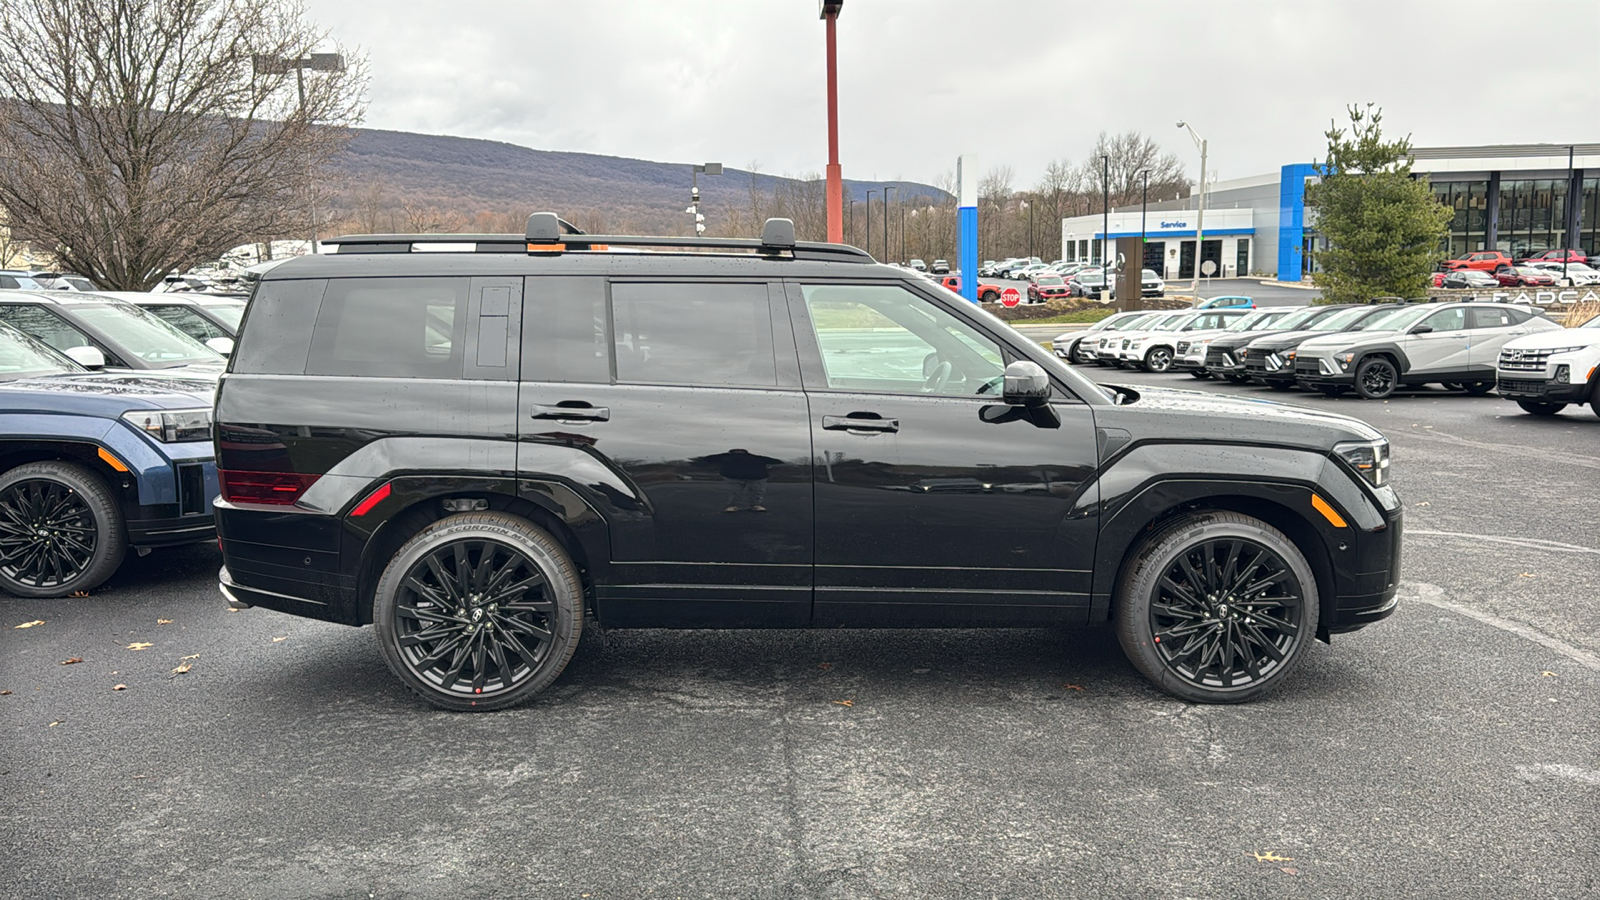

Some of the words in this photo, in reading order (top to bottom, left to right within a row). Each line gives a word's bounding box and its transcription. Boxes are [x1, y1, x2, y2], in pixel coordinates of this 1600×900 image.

[1160, 220, 1187, 229] Service
[1002, 293, 1020, 302] STOP
[446, 524, 510, 535] SCORPION
